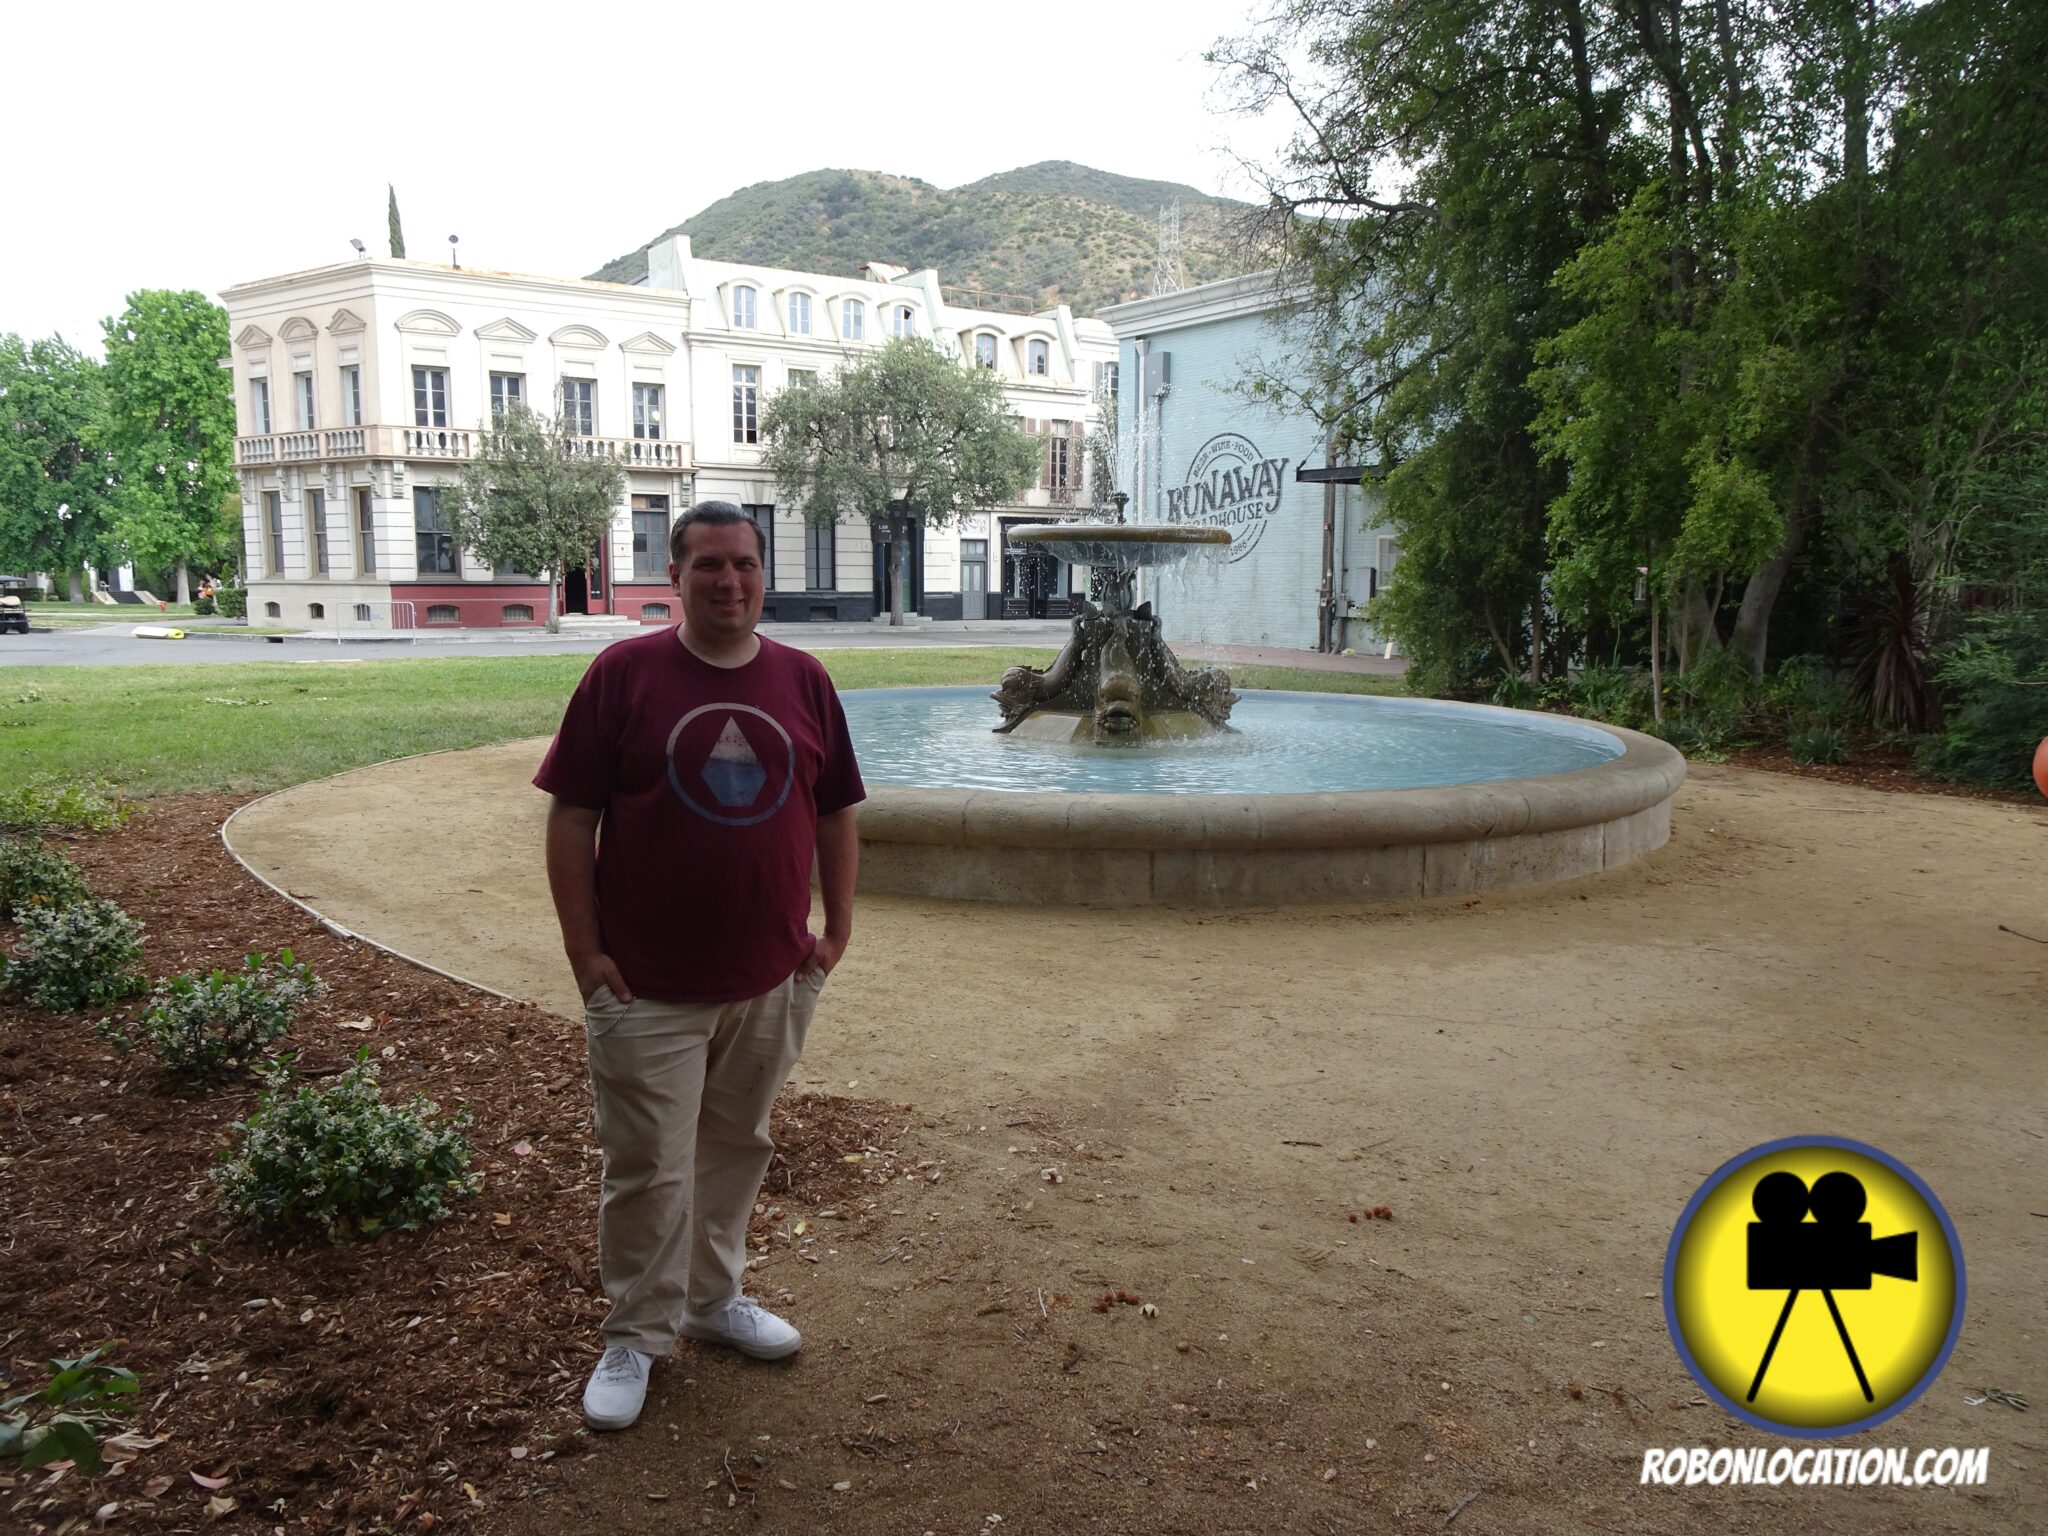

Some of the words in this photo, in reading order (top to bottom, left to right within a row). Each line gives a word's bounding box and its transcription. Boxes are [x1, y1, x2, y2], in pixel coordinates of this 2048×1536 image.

[1193, 452, 1209, 478] BEER
[1211, 440, 1231, 454] WINE
[1234, 441, 1254, 461] FOOD
[1167, 457, 1290, 524] RUNAWAY
[1184, 502, 1264, 527] OADHOUSE
